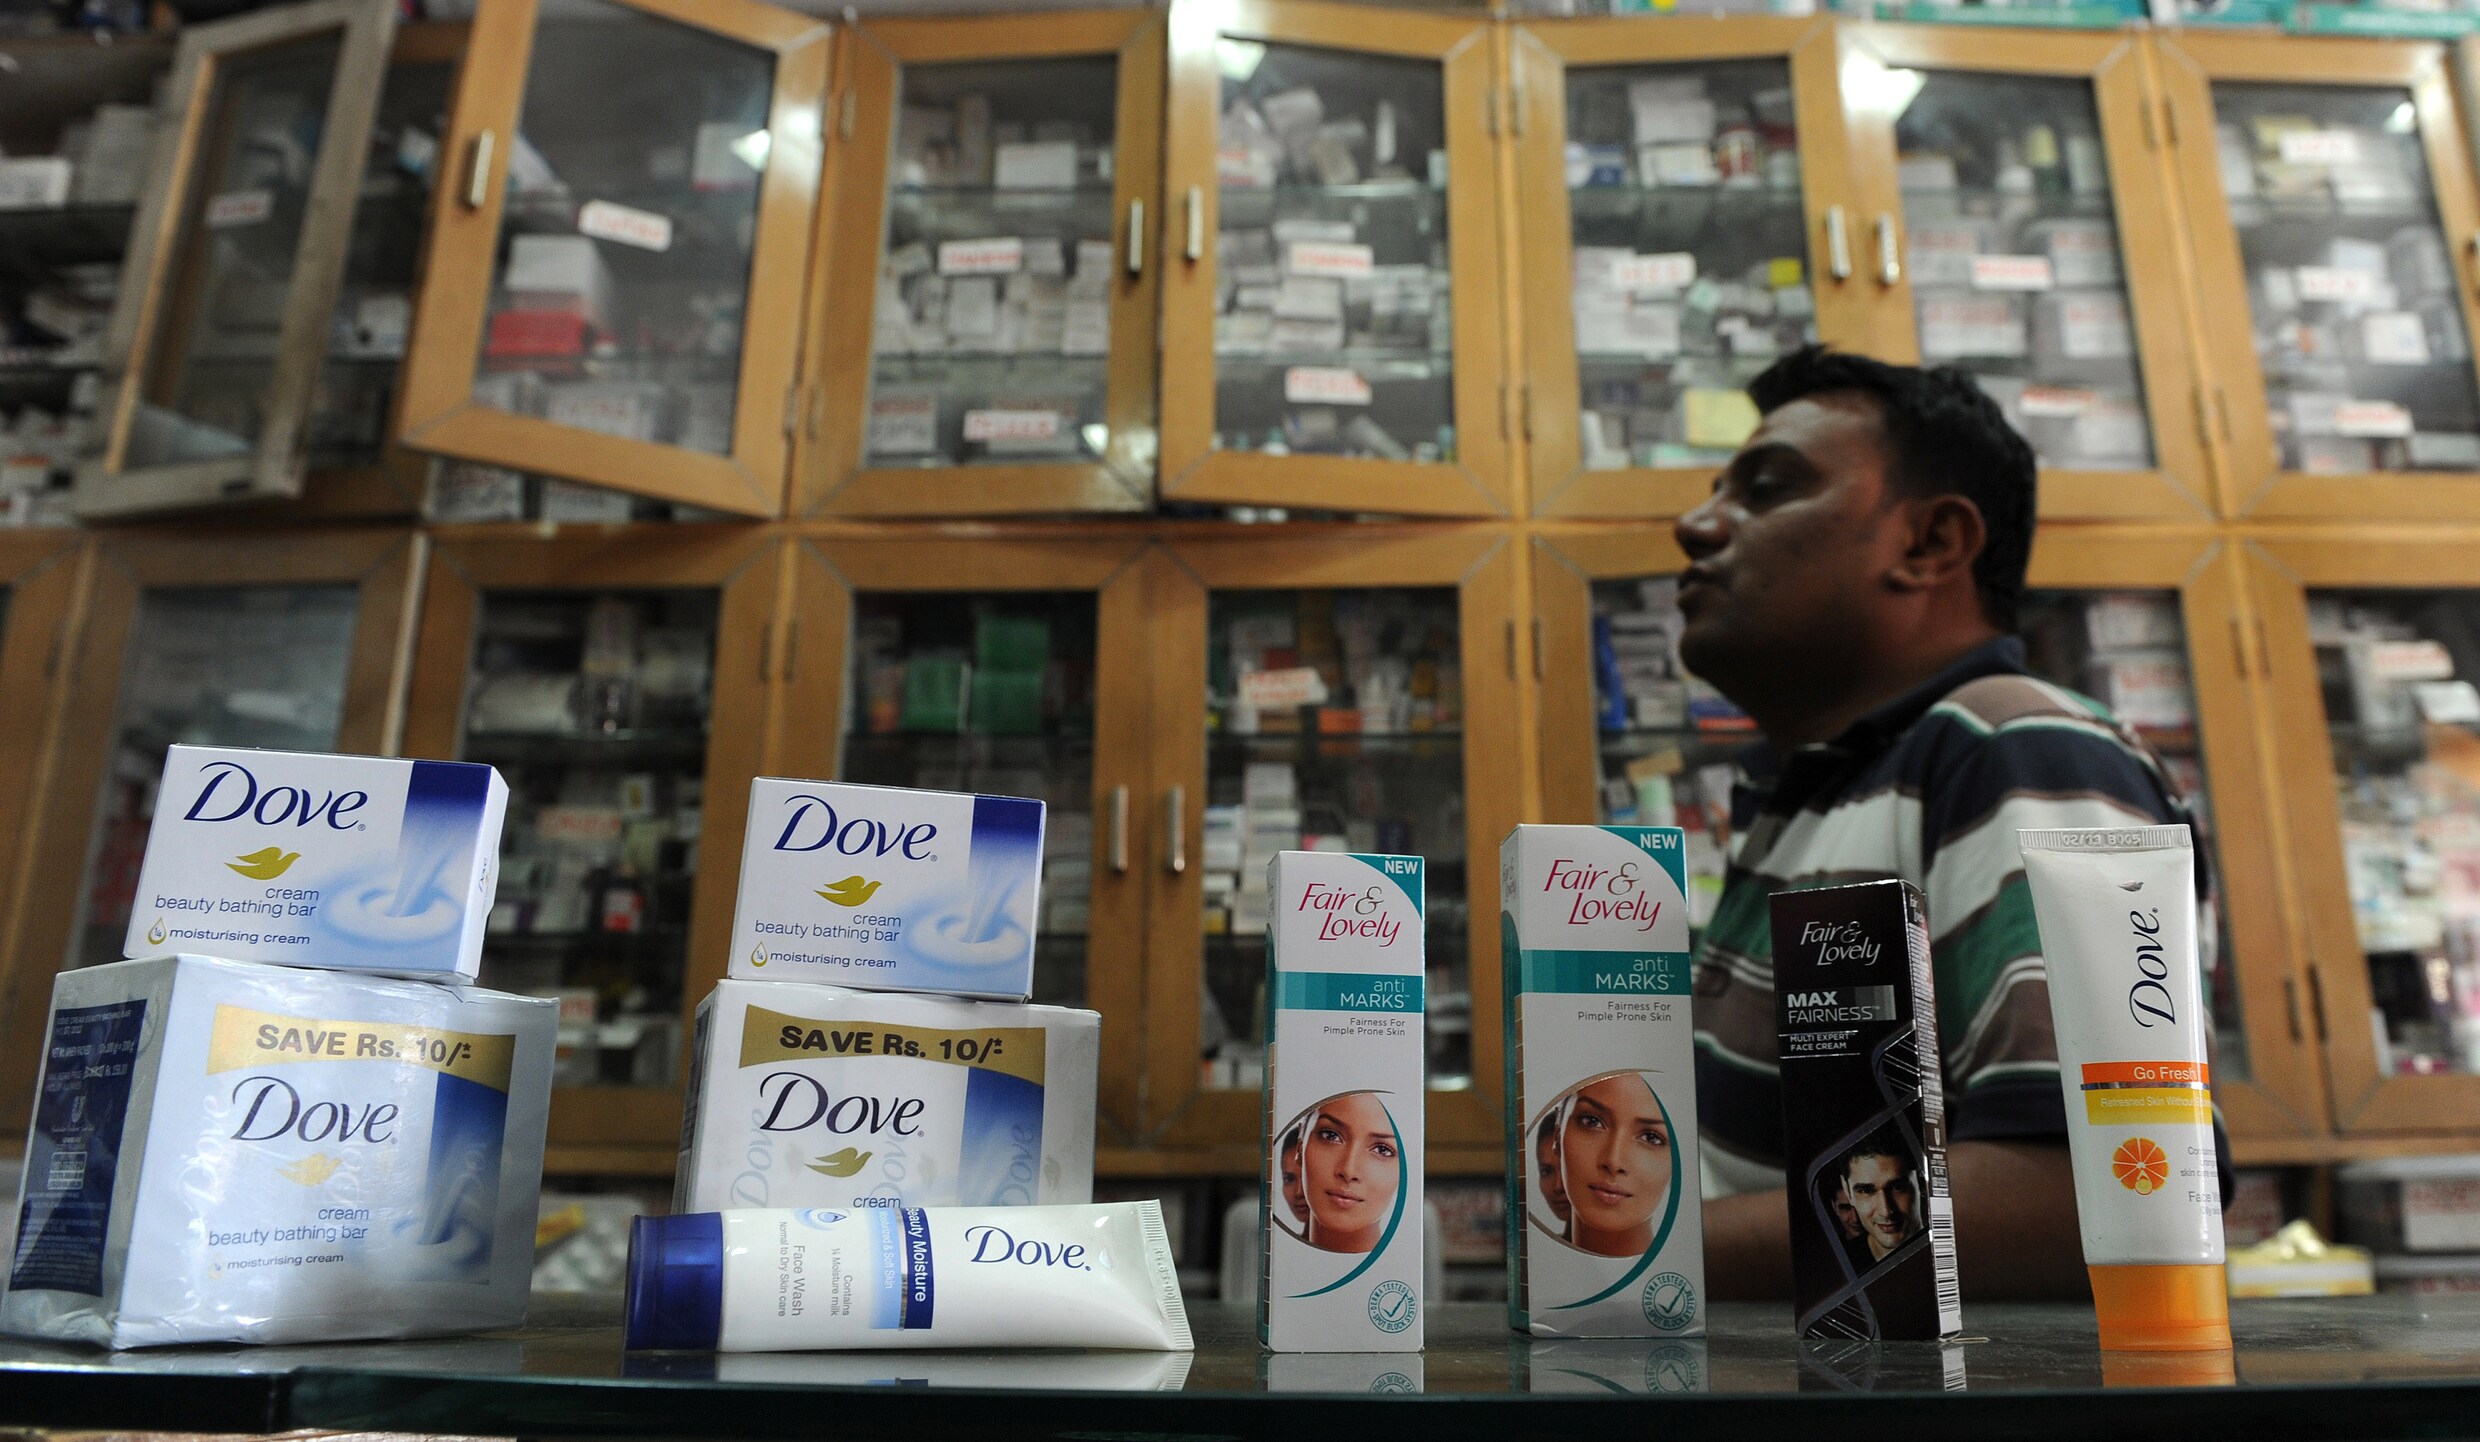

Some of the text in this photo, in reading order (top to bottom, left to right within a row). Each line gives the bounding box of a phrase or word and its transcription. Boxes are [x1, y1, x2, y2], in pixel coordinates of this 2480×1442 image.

[1640, 833, 1678, 850] NEW
[1384, 861, 1418, 875] NEW
[1544, 859, 1608, 892] Fair
[1608, 863, 1641, 895] &
[265, 884, 320, 902] cream
[1298, 883, 1357, 911] Fair
[1354, 886, 1384, 915] &
[155, 894, 317, 919] beauty bathing bar
[1568, 890, 1661, 931] Lovely
[853, 913, 901, 927] cream
[1319, 911, 1400, 947] Lovely
[169, 927, 259, 945] moisturising
[263, 932, 310, 944] cream
[755, 920, 900, 944] beauty bathing bar
[1800, 920, 1862, 945] Fair &
[770, 952, 850, 967] moisturising
[855, 956, 897, 968] cream
[1817, 937, 1881, 966] Lovely
[1633, 956, 1669, 972] anti
[1374, 978, 1405, 993] anti
[1607, 1001, 1671, 1012] Fairness For
[1787, 991, 1838, 1009] MAX
[1350, 1018, 1406, 1028] Fairness For
[1577, 1011, 1672, 1023] Pimple Prone Skin
[256, 1023, 347, 1056] SAVE
[780, 1025, 873, 1054] SAVE
[1323, 1026, 1406, 1038] Pimple Prone Skin
[1790, 1033, 1815, 1042] MULTI
[1791, 1042, 1847, 1051] FACE CREAM
[2133, 1066, 2197, 1080] Go Fresh
[853, 1196, 901, 1210] cream
[318, 1207, 369, 1222] cream
[208, 1222, 368, 1247] beauty bathing bar
[227, 1252, 344, 1271] moisturising cream
[778, 1221, 789, 1317] Normal to Dry Skin care
[792, 1245, 805, 1316] Face Wash
[832, 1257, 842, 1294] Moisture
[885, 1270, 896, 1289] Skin
[912, 1241, 928, 1303] Moisture
[842, 1275, 853, 1316] Contains
[830, 1296, 842, 1316] milk
